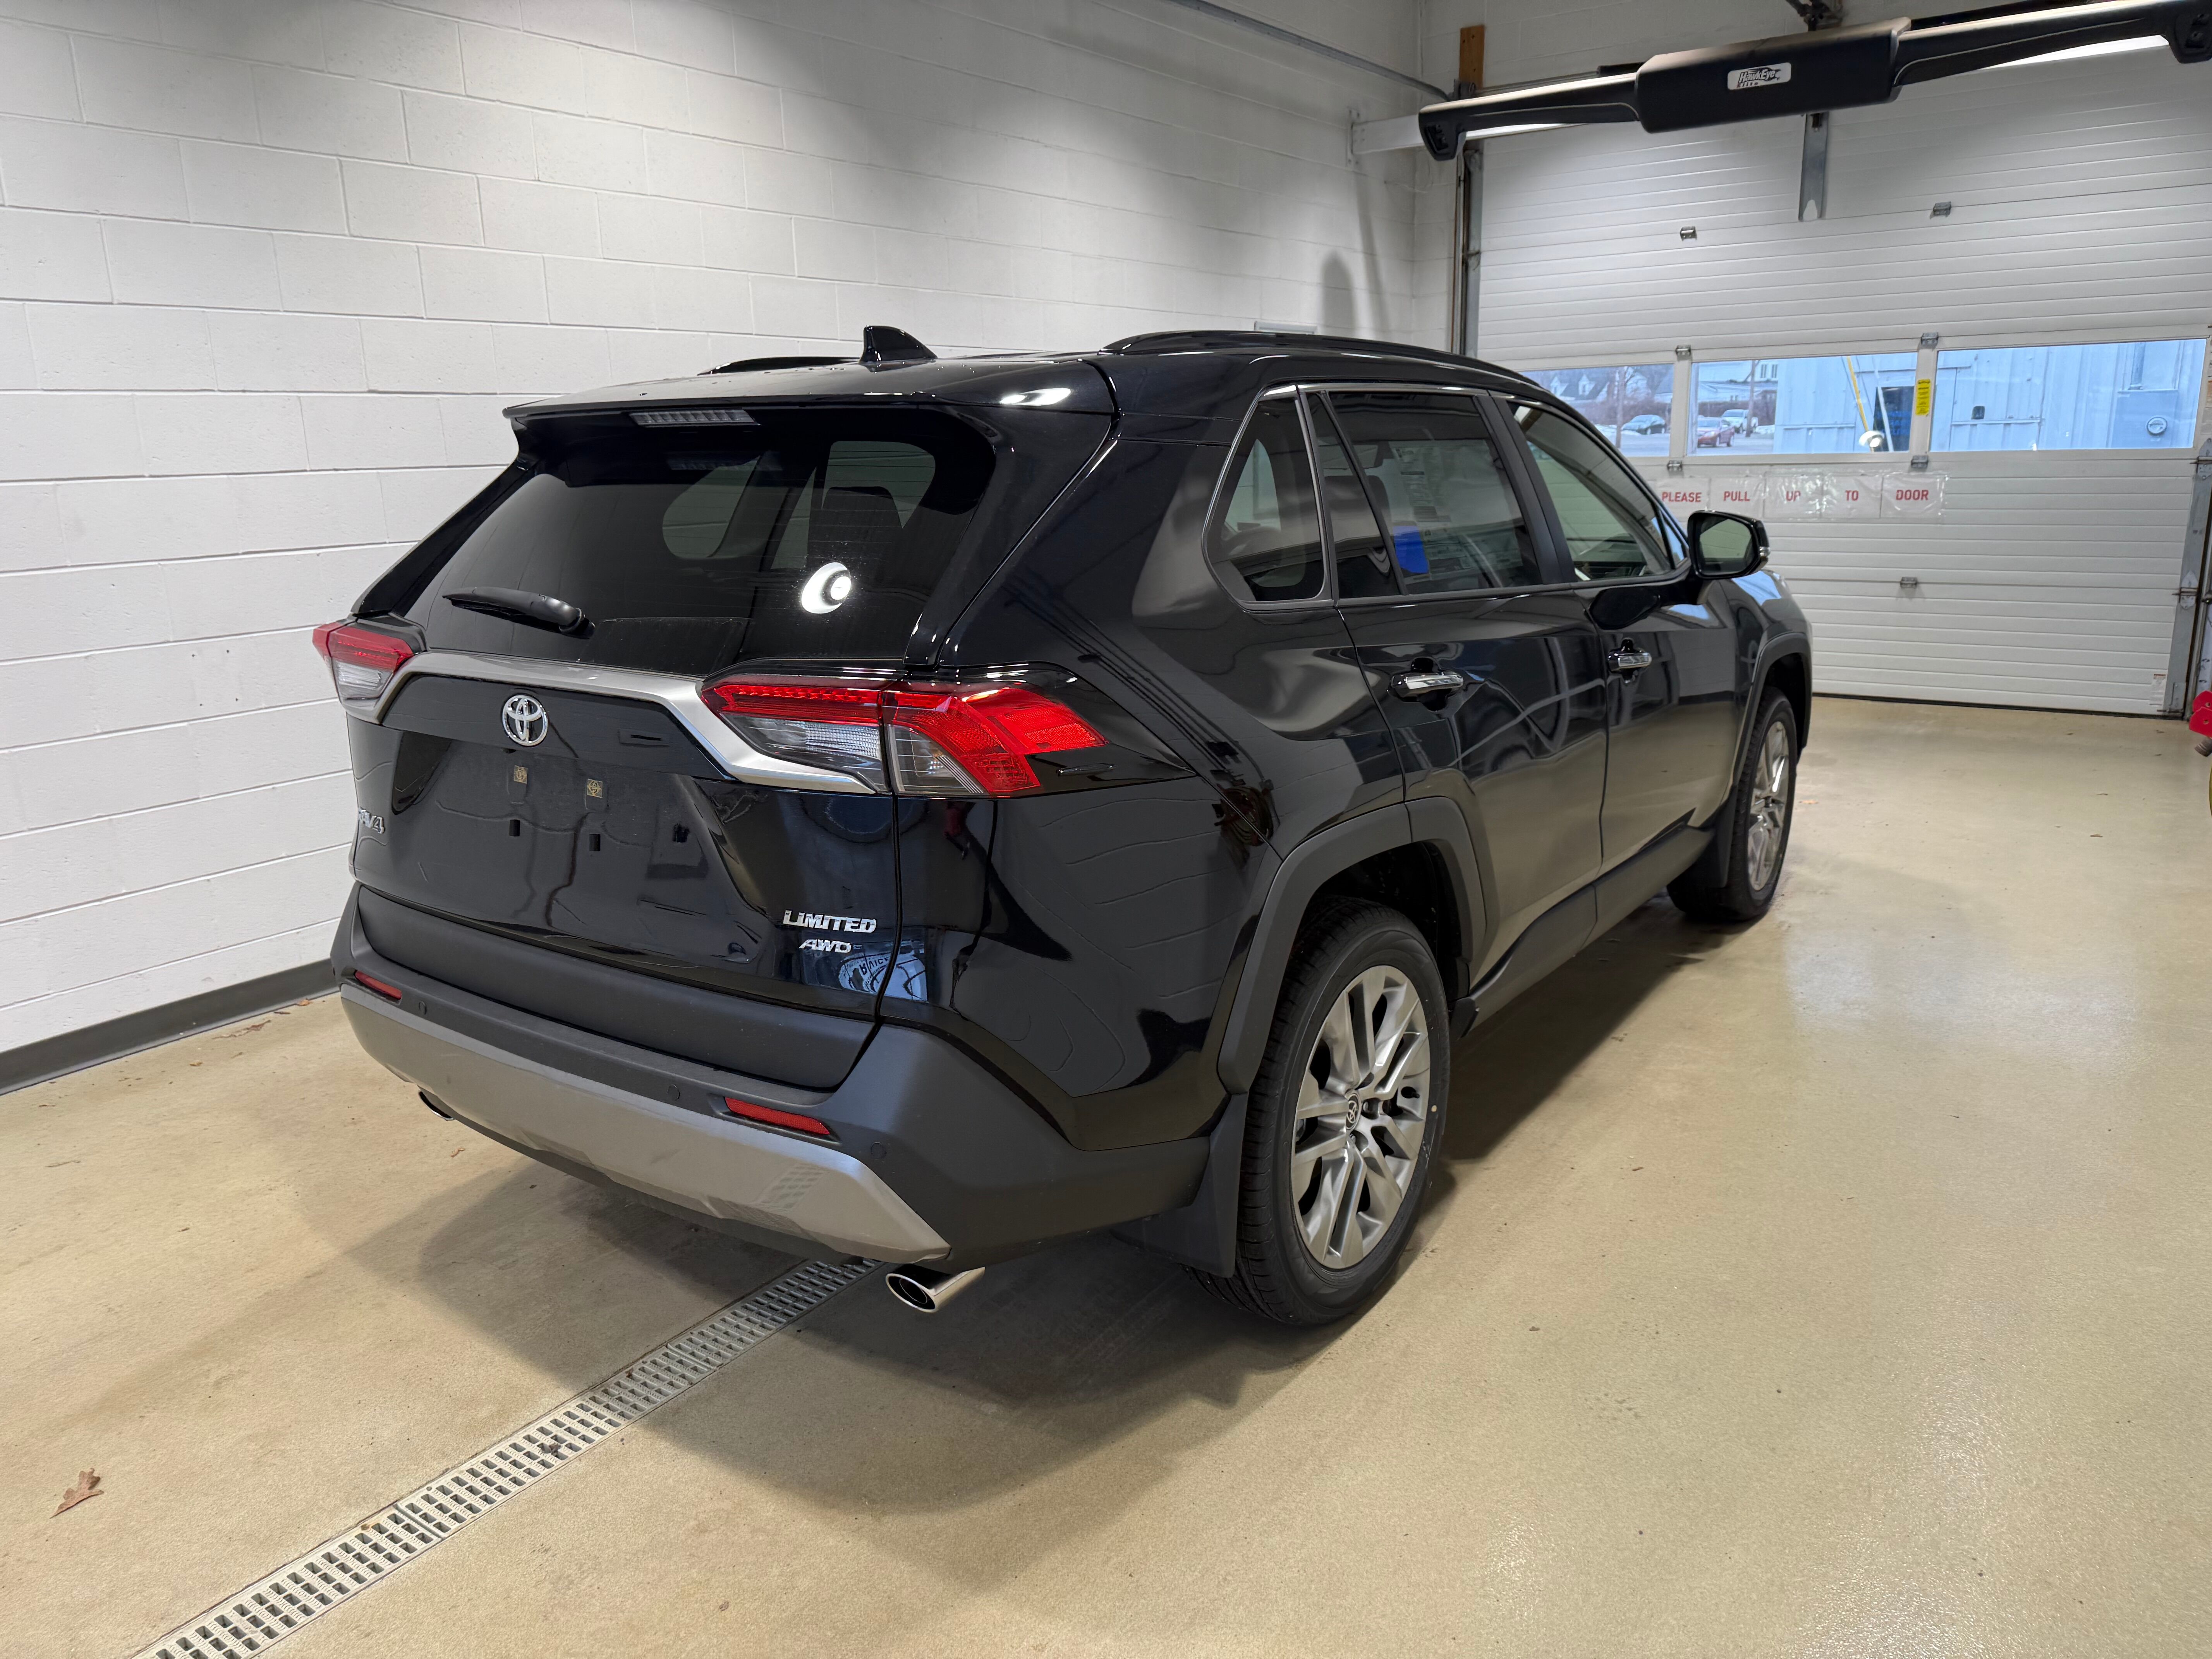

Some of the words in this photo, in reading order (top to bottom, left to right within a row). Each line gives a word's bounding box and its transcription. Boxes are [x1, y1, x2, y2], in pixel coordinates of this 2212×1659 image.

[1662, 491, 1702, 502] PLEASE
[1724, 491, 1750, 501] PULL
[1786, 491, 1801, 501] UP
[1845, 490, 1858, 501] TO
[1896, 489, 1929, 501] DOOR
[783, 910, 877, 933] LIMITED
[799, 939, 852, 953] AWD
